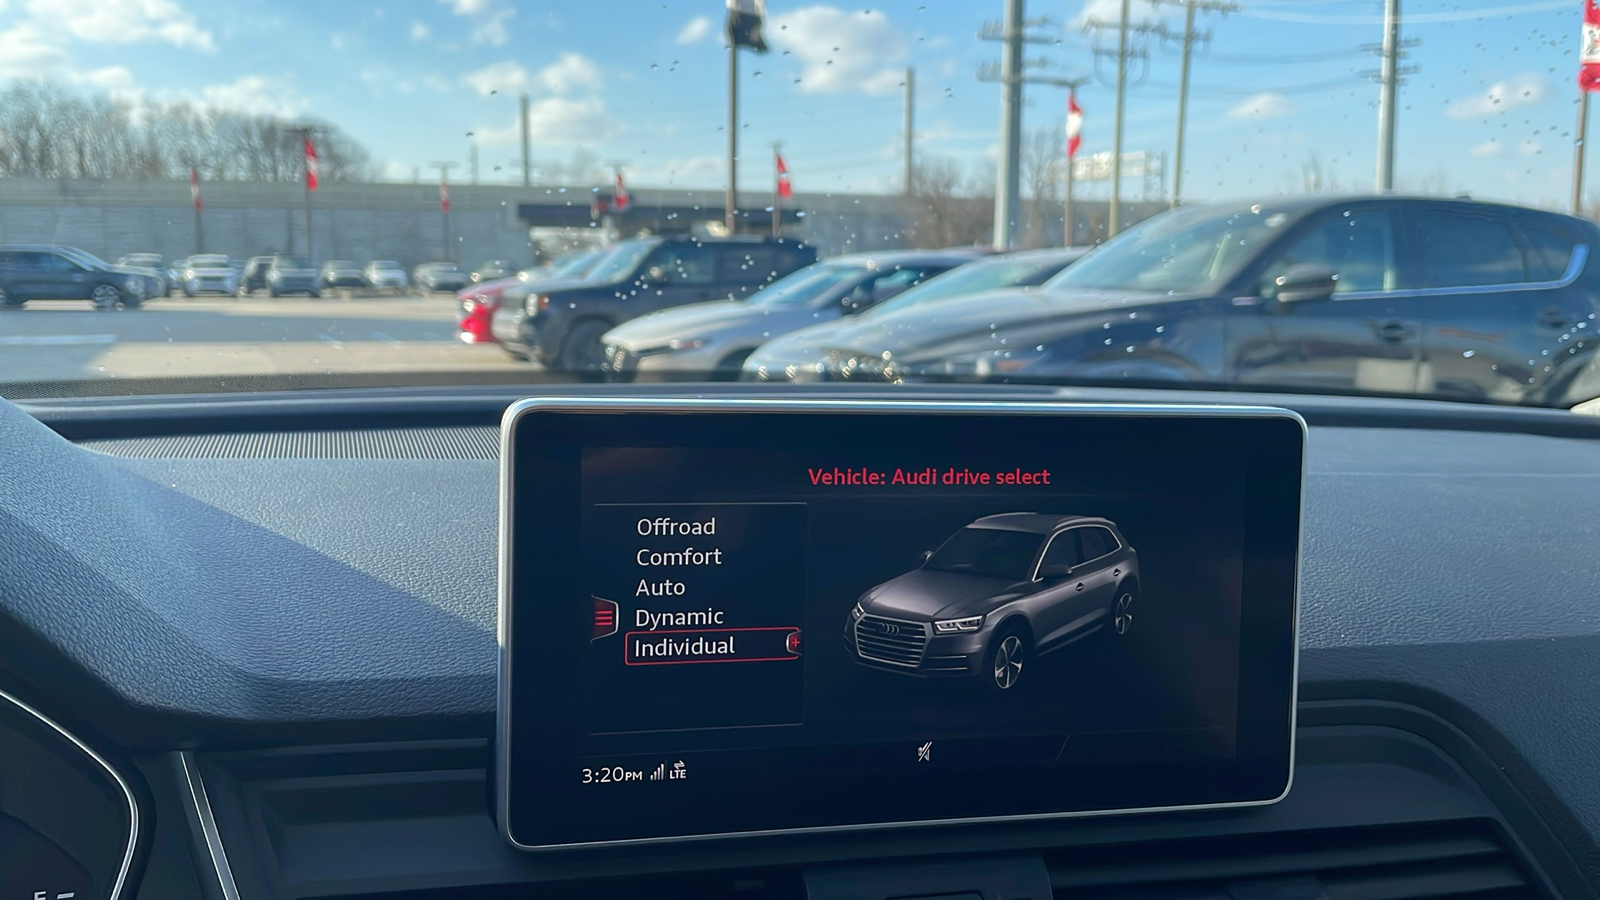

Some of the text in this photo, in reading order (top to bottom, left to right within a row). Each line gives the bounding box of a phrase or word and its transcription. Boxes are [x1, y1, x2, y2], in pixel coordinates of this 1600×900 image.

[808, 468, 1051, 485] Vehicle: Audi drive select
[637, 517, 716, 536] Offroad
[636, 547, 722, 566] Comfort
[636, 579, 686, 597] Auto
[636, 607, 724, 631] Dynamic
[635, 636, 735, 657] Individual
[669, 769, 687, 780] LTE
